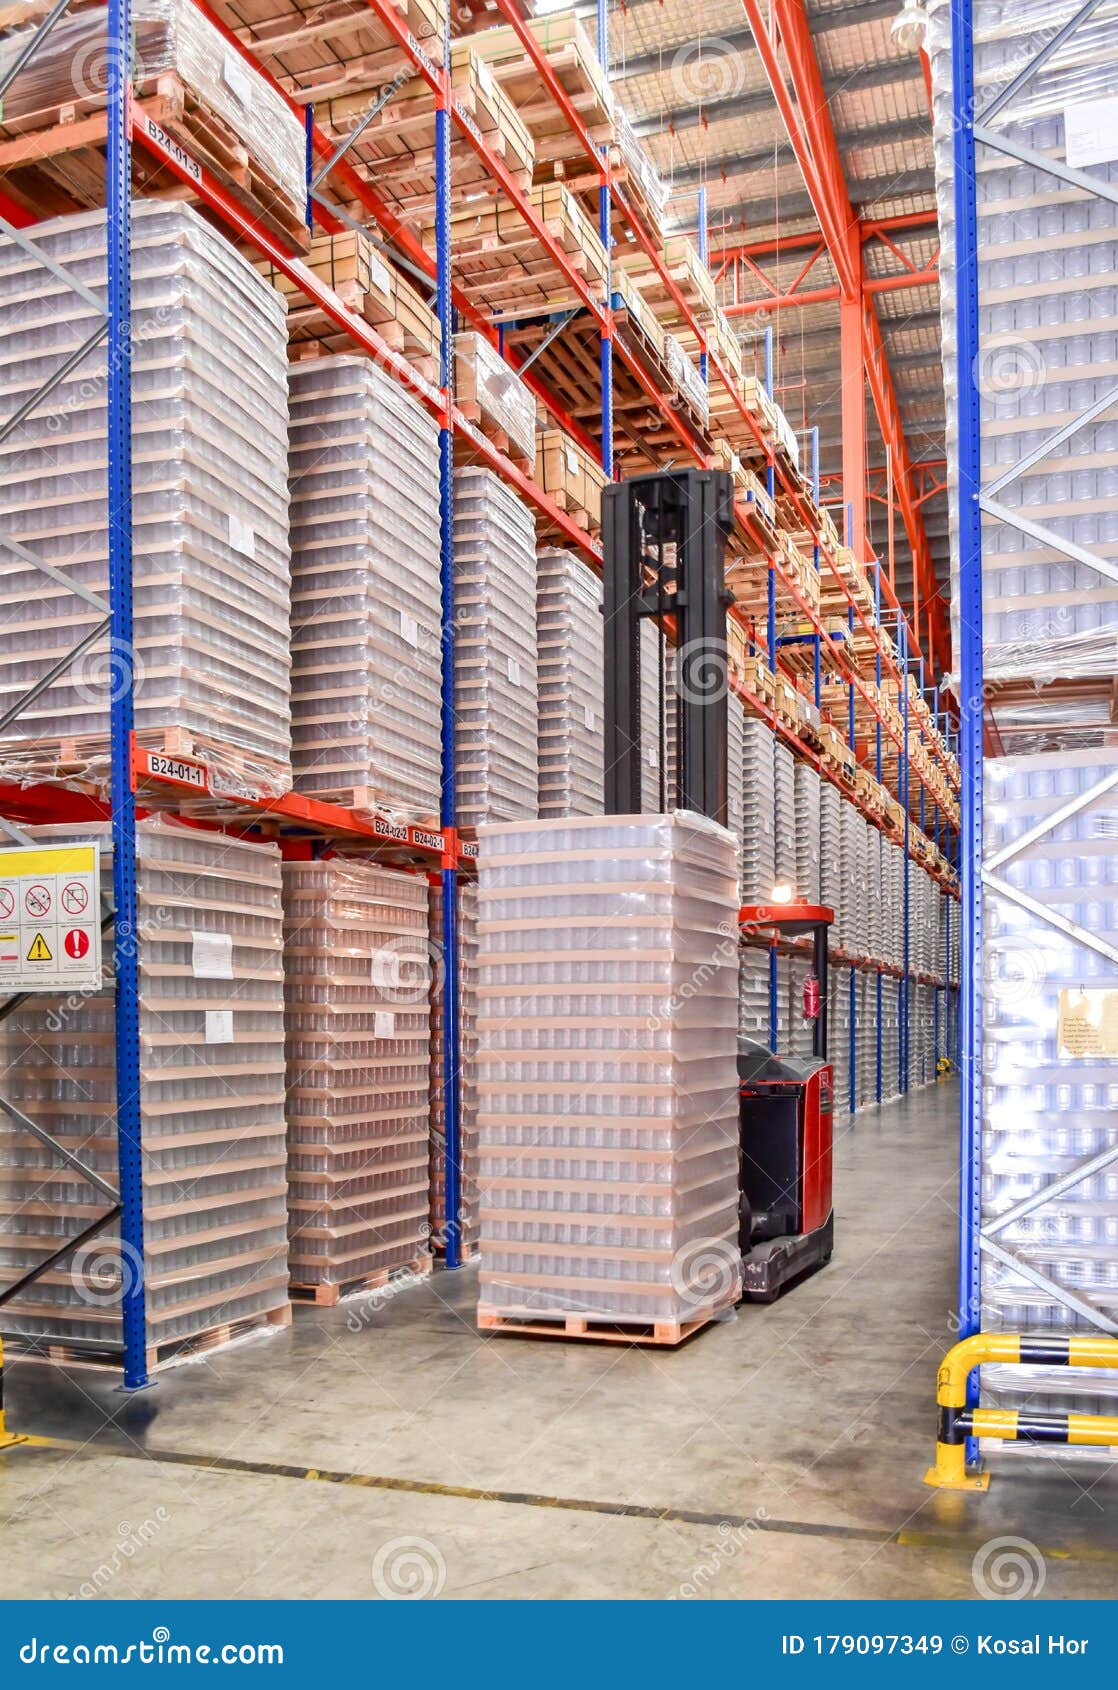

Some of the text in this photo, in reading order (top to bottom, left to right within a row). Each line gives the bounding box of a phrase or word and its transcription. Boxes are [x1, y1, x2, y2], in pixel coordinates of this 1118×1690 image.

[148, 120, 201, 178] B24-01-3
[151, 756, 201, 785] B24-01-1
[375, 820, 443, 849] B24-02-2 B24-02-1
